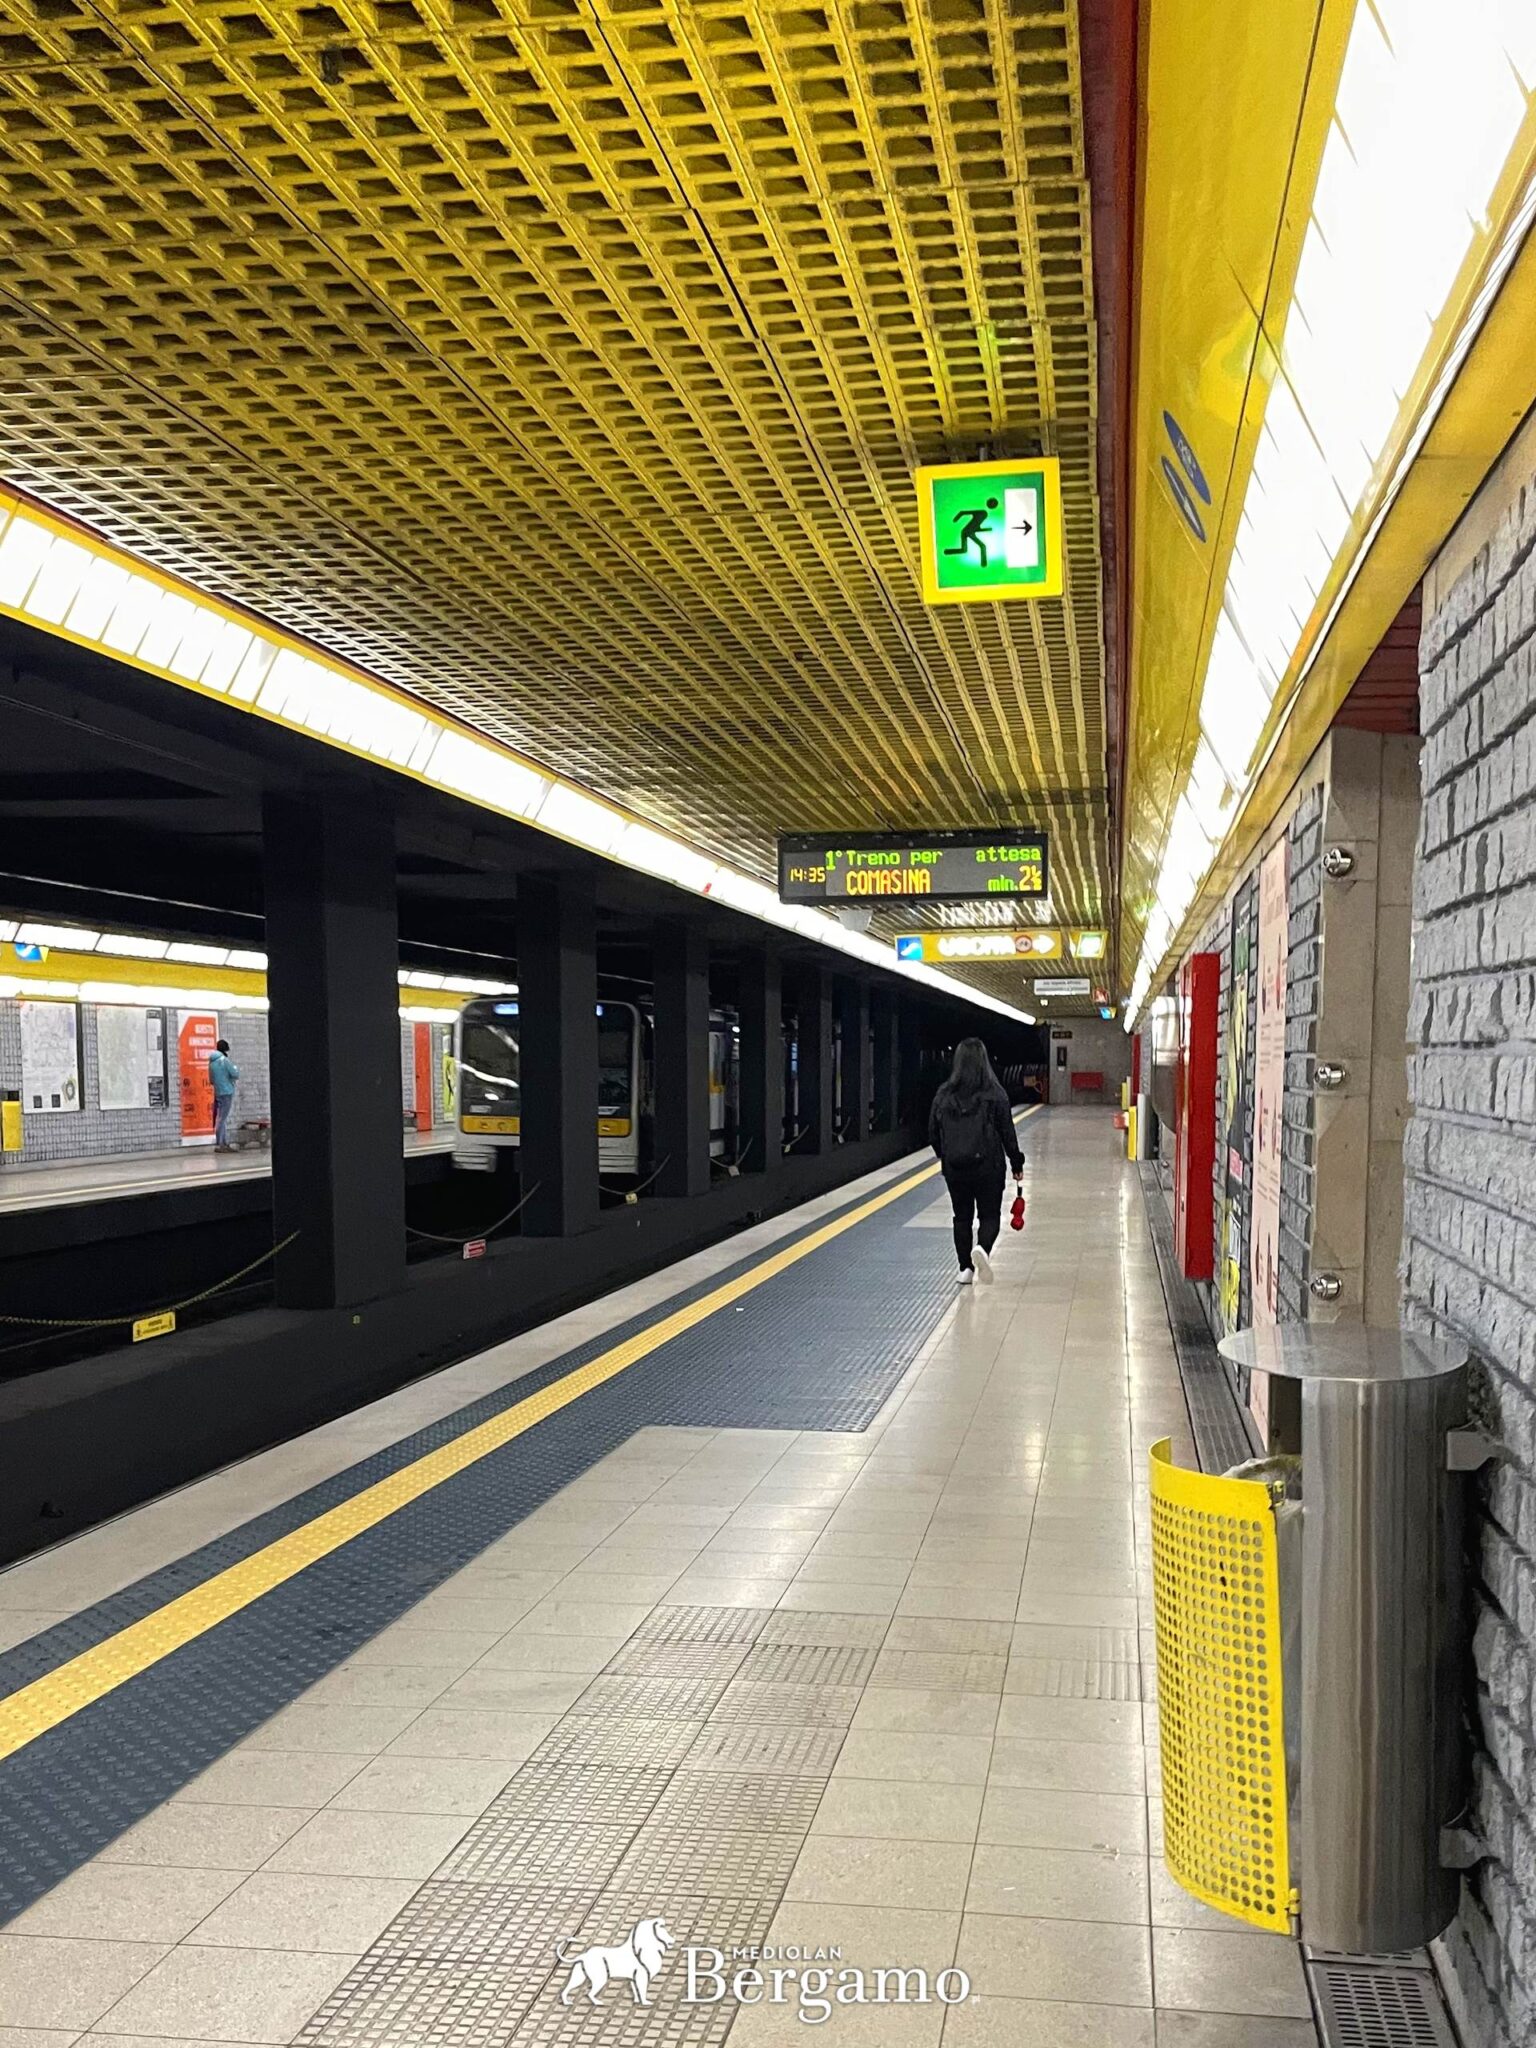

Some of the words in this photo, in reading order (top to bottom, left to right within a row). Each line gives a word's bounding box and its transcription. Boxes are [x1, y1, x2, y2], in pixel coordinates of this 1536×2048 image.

[847, 850, 900, 866] Treno
[910, 850, 943, 866] per
[976, 846, 1042, 862] attesa
[790, 867, 826, 883] 14:35
[846, 869, 931, 896] COMASINA
